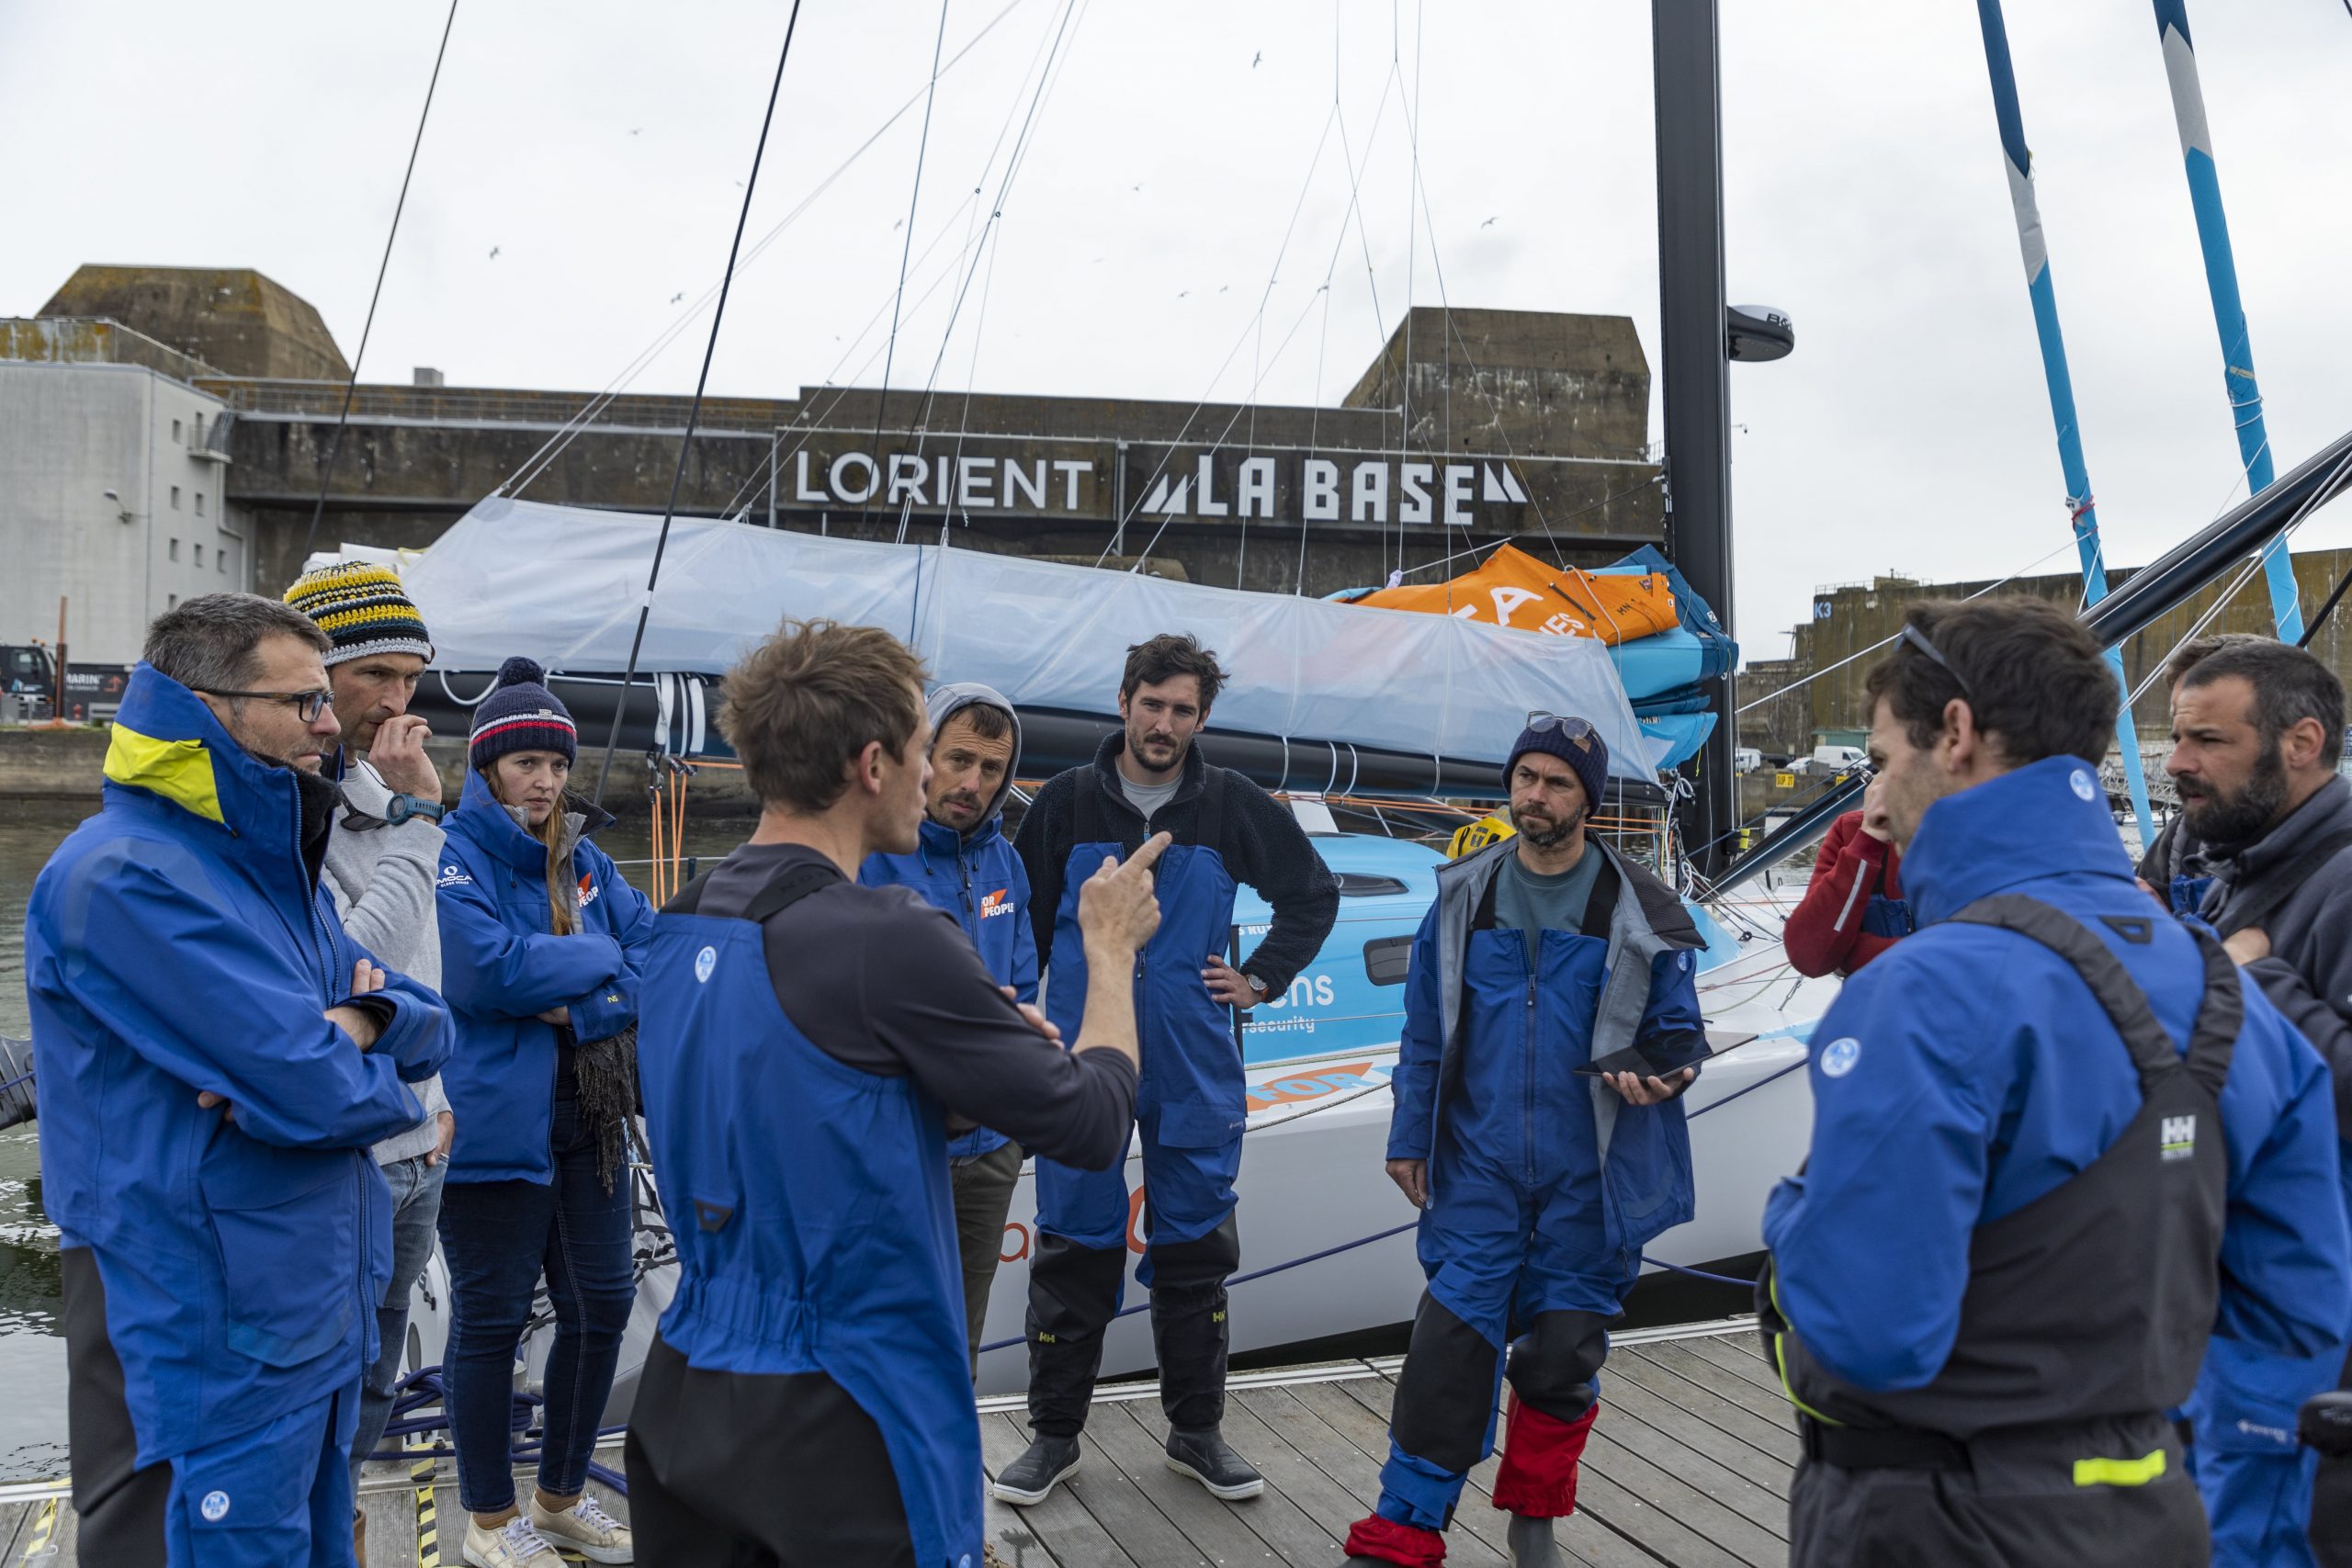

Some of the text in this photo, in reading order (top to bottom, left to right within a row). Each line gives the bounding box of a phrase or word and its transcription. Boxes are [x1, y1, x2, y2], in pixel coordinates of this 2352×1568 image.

[797, 450, 1093, 510] LORIENT
[1197, 455, 1475, 525] LA BASE
[1815, 602, 1832, 618] K3
[984, 902, 1014, 918] PEOPLE
[2161, 1114, 2197, 1145] HH
